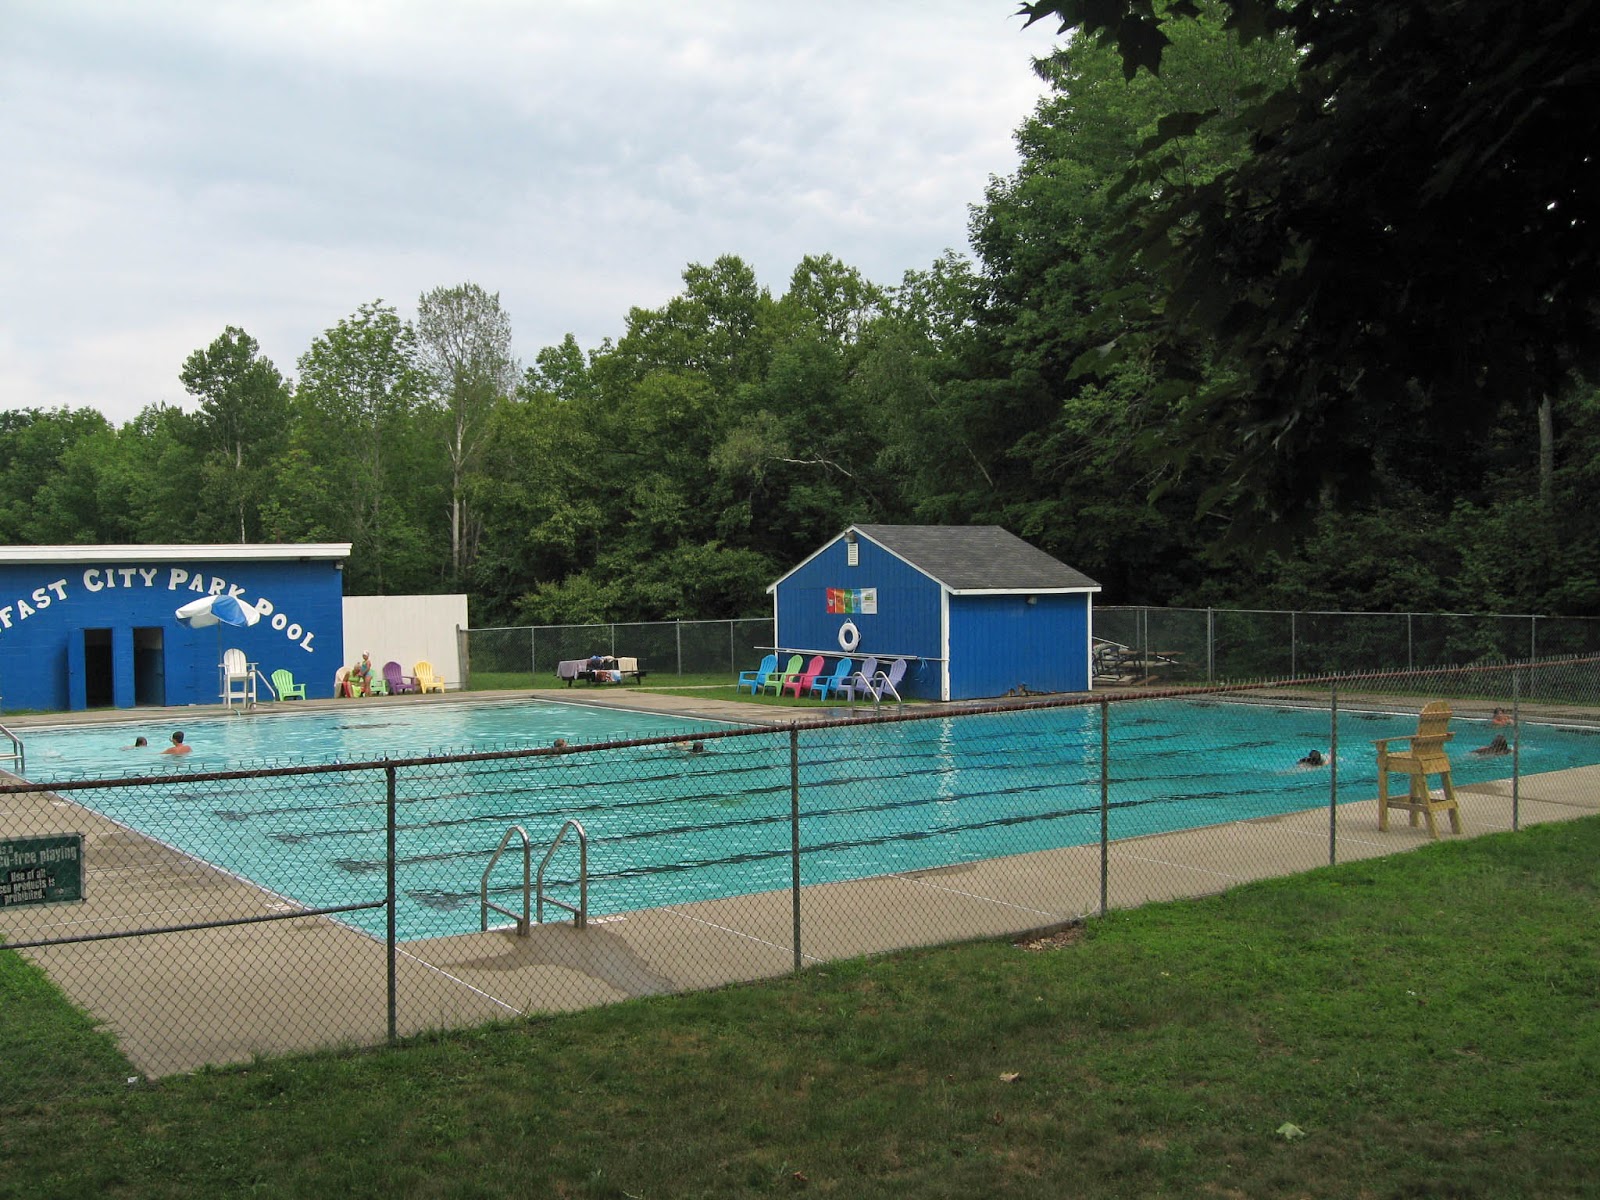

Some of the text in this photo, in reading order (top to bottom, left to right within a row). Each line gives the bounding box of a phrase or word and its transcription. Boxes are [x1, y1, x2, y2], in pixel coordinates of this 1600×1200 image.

[0, 567, 315, 653] FAST CITY PARK POOL
[40, 845, 77, 865] playing
[14, 879, 47, 894] products
